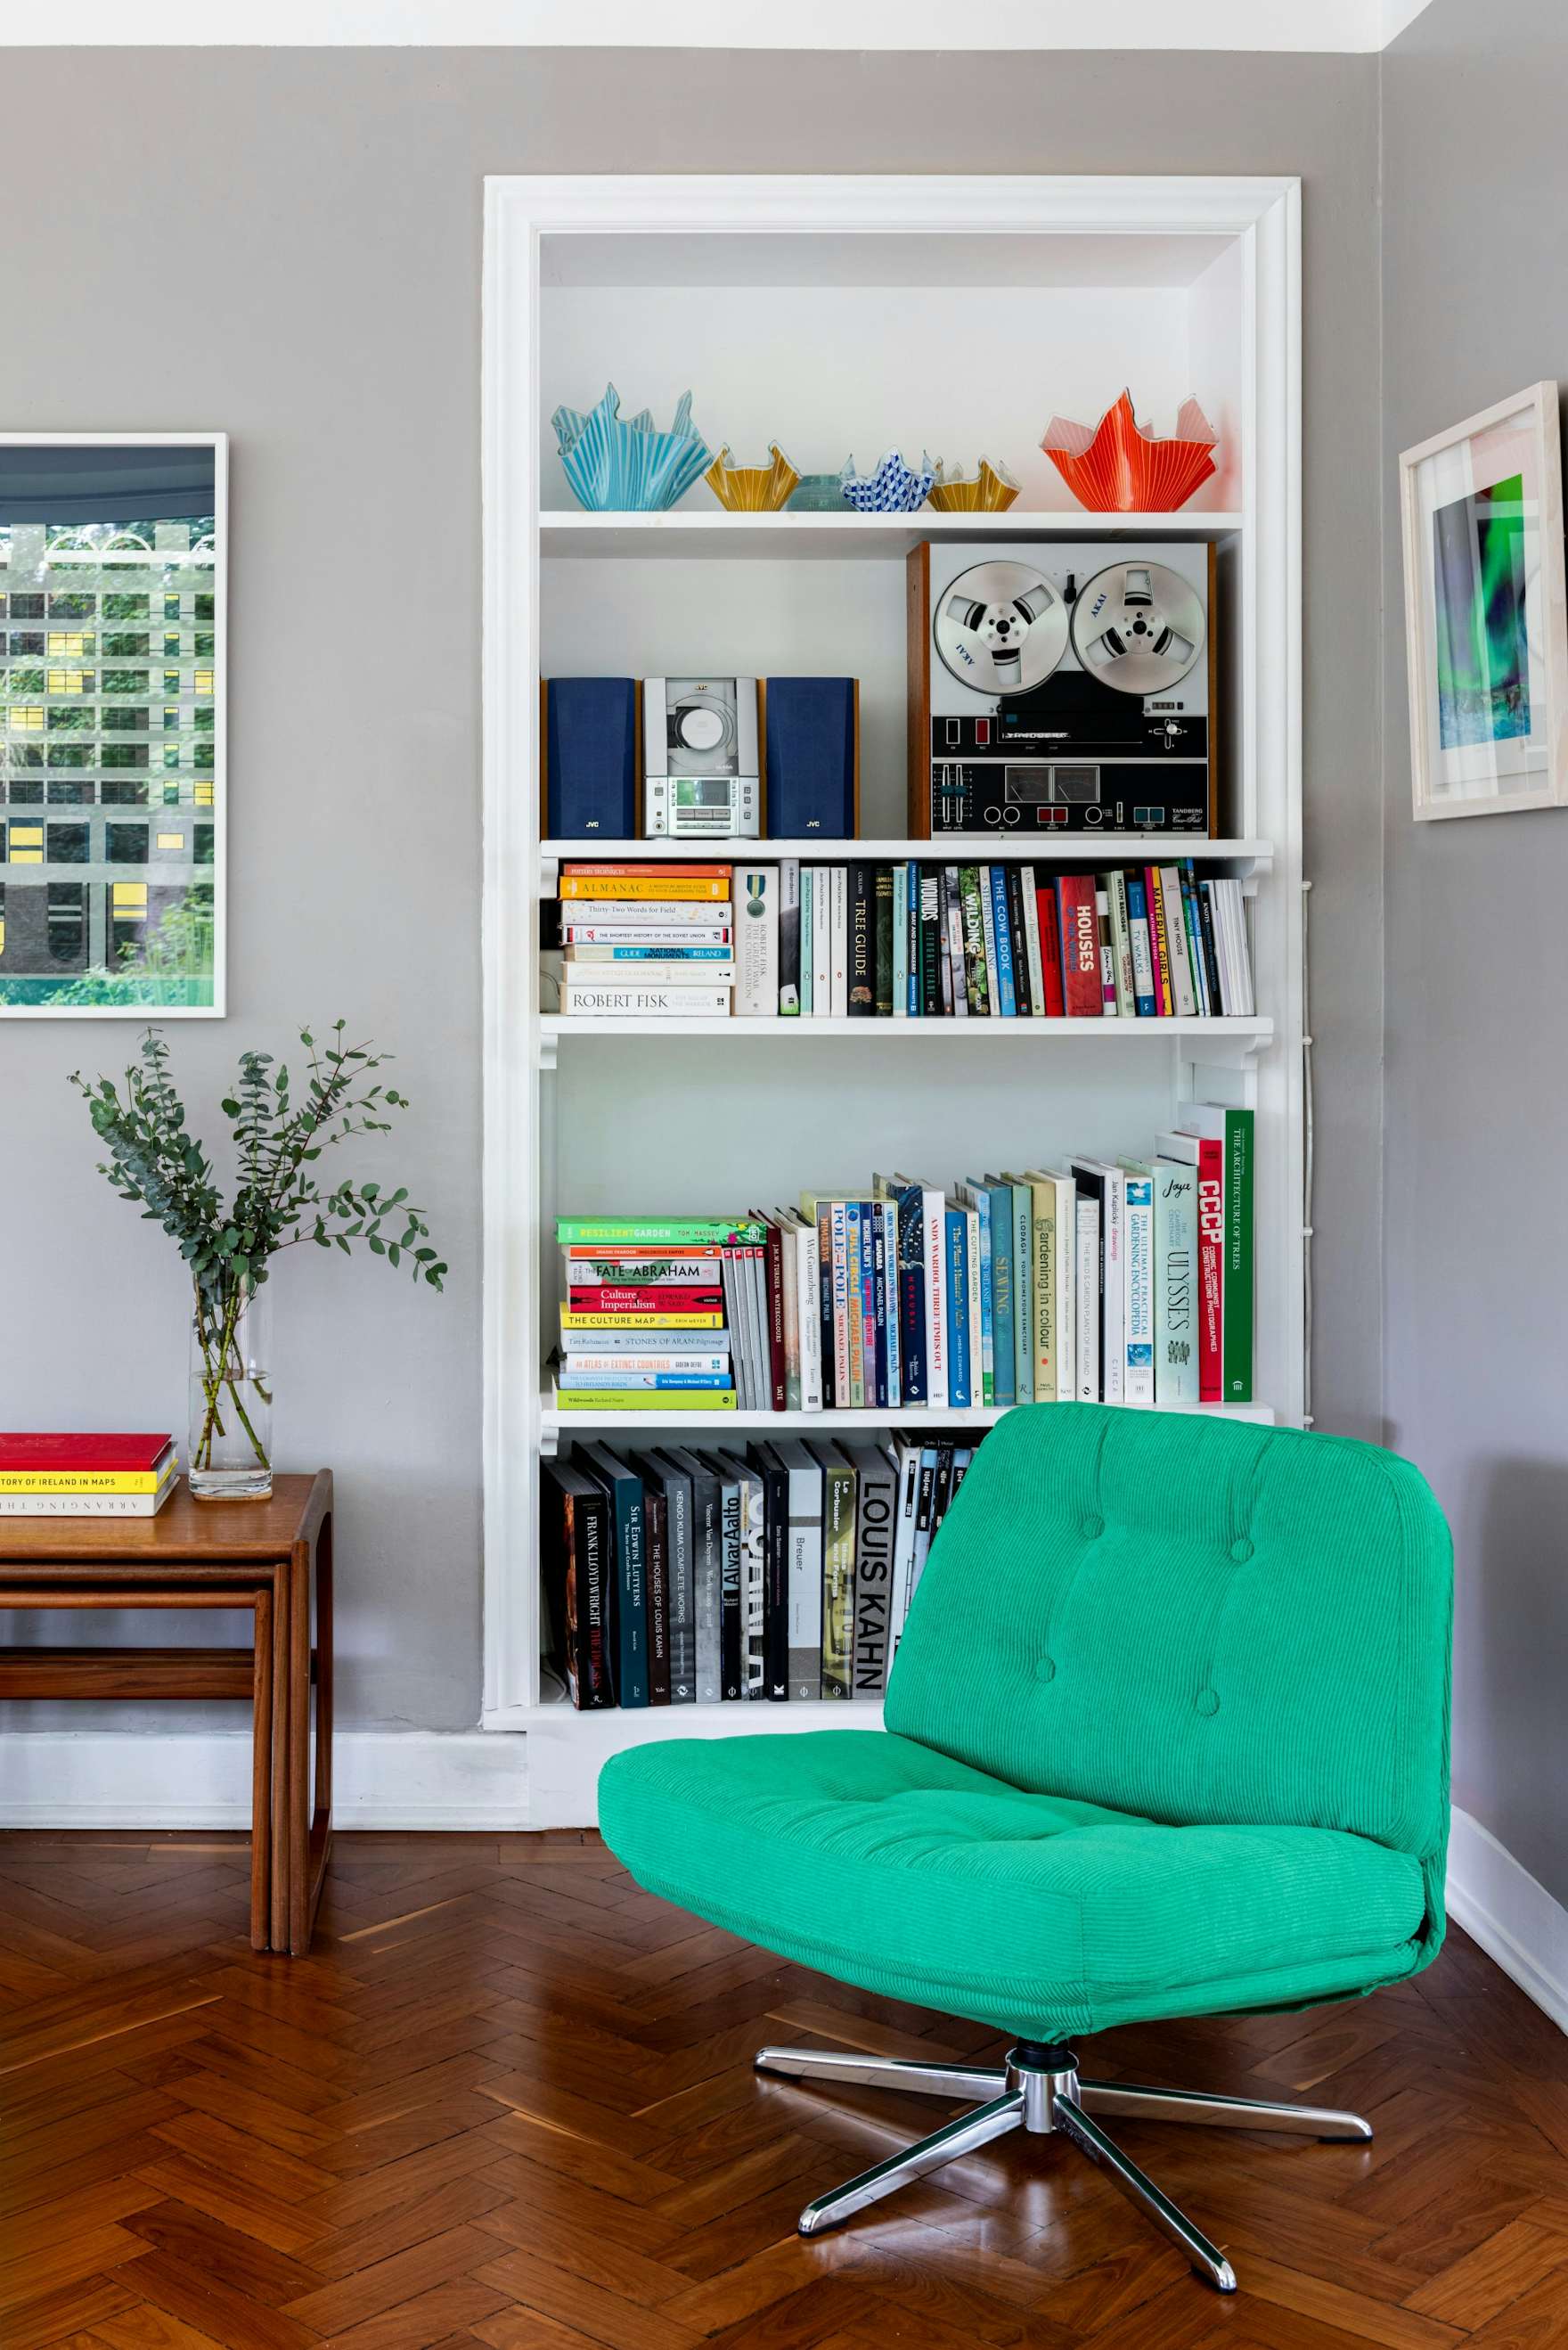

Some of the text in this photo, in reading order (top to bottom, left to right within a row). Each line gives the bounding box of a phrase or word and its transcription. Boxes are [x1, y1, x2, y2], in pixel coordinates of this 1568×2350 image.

[1090, 593, 1107, 618] AKAI
[583, 884, 644, 892] ALMANAC
[921, 877, 938, 921] WOUNDS
[856, 899, 866, 975] TREE GUIDE
[965, 893, 981, 954] WILDING
[982, 884, 996, 970] STEPHEN HAWKING
[995, 879, 1009, 970] THE COW BOOK
[1077, 905, 1094, 971] HOUSES
[1153, 888, 1168, 984] MATERIAL GIRLS
[1133, 929, 1144, 974] TV WALKS
[1175, 933, 1183, 956] HOUSE
[574, 994, 632, 1007] ROBERT
[637, 994, 669, 1007] FISK
[1163, 1179, 1192, 1198] Joyce
[807, 1239, 815, 1254] Wu
[820, 1216, 829, 1262] HIMALAYA
[834, 1210, 844, 1253] POLE
[953, 1226, 962, 1243] The
[1110, 1228, 1119, 1261] drawings
[1198, 1180, 1223, 1308] CCCP COSMIC COMMUNIST
[1233, 1226, 1241, 1238] OF
[596, 1266, 699, 1277] FATE ABRAHAM
[932, 1245, 940, 1285] WARHOL
[954, 1245, 962, 1266] Plant
[1131, 1214, 1141, 1335] GARDENING ENCYCLOPEDIA
[1233, 1241, 1241, 1270] TREES
[601, 1290, 637, 1299] Culture
[806, 1256, 816, 1305] Guanzhong
[835, 1265, 845, 1309] POLE
[955, 1269, 964, 1305] Hunter's
[996, 1257, 1009, 1314] SEWING
[1167, 1251, 1190, 1331] ULYSSES
[1203, 1246, 1217, 1352] CONSTRUCTIONS PHOTOGRAPHED
[601, 1300, 655, 1311] Imperialism
[850, 1228, 861, 1382] FULL CIRCLE MICHAEL PALIN
[933, 1287, 941, 1319] THREE
[1039, 1293, 1055, 1349] in colour
[933, 1321, 941, 1349] TIMES
[1084, 1336, 1090, 1345] OF
[584, 1360, 670, 1368] ATLAS EXTINCT COUNTRIES
[843, 1481, 849, 1494] Le
[676, 1491, 686, 1623] KENGO KUMA COMPLETE WORKS
[704, 1542, 713, 1566] Duysen
[796, 1537, 805, 1571] Breuer
[587, 1516, 602, 1689] FRANK LLOYD WRIGHT THE HOUSES
[655, 1596, 662, 1607] OF
[856, 1482, 890, 1690] LOUIS KAHN
